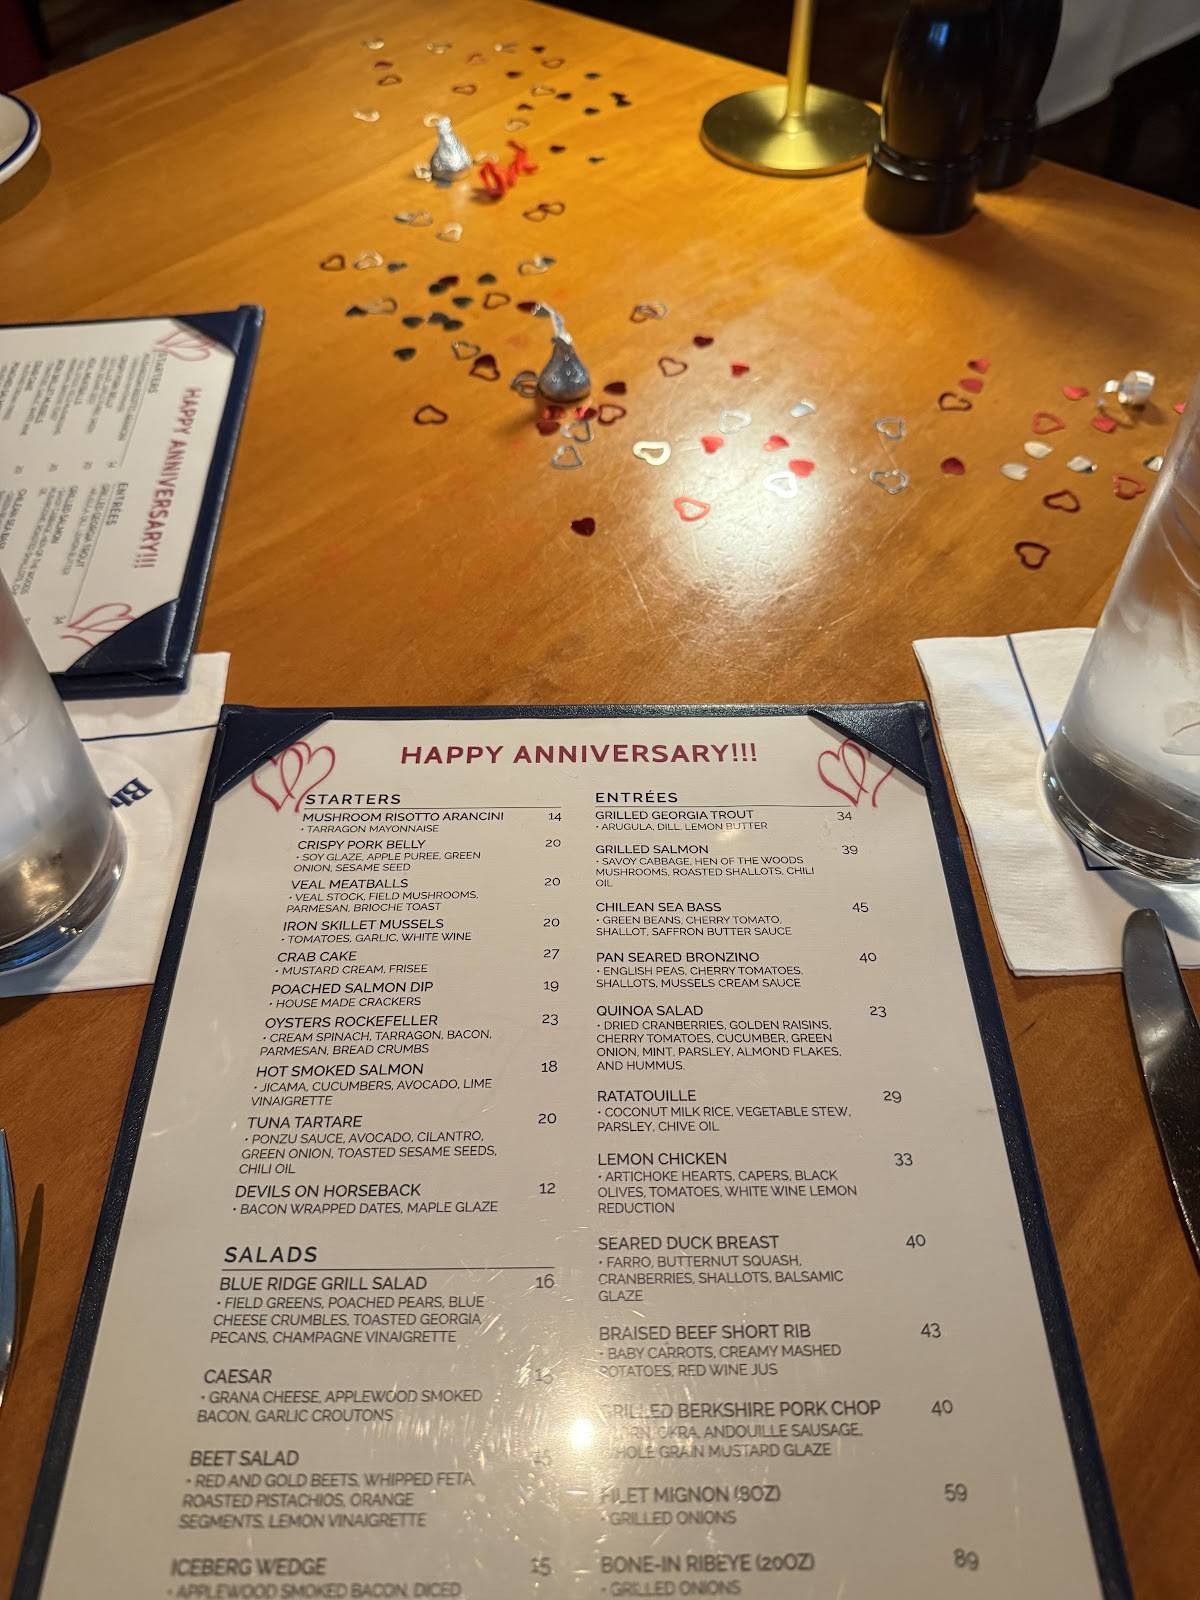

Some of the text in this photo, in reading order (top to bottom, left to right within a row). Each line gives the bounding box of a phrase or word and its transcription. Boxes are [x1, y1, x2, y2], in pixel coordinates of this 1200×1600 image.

[134, 387, 201, 569] HAPPY ANNIVERSARY!!!
[401, 742, 758, 765] HAPPY ANNIVERSARY!!!
[304, 793, 402, 805] STARTERS
[595, 789, 678, 803] ENTRÉES
[302, 811, 504, 822] MUSHROOM RISOTTO ARANCINI
[547, 812, 562, 822] 14
[594, 809, 754, 820] GRILLED GEORGIA TROUT
[836, 810, 853, 821] 34
[307, 824, 439, 833] TARRAGON MAYONNAISE
[297, 839, 426, 850] CRISPY PORK BELLY
[544, 838, 562, 848] 20
[595, 844, 709, 854] GRILLED SALMON
[841, 844, 858, 855] 39
[334, 862, 380, 872] SESAME
[382, 862, 411, 872] SEED
[290, 877, 409, 890] VEAL MEATBALLS
[544, 876, 561, 886] 20
[352, 902, 403, 912] BRIOCHE
[405, 901, 441, 911] TOAST
[595, 901, 722, 912] CHILEAN SEA BASS
[851, 901, 869, 913] 45
[282, 917, 444, 931] IRON SKILLET MUSSELS
[543, 917, 560, 927] 20
[401, 931, 439, 942] WHITE
[440, 931, 472, 941] WINE
[651, 926, 704, 936] SAFFRON
[706, 926, 752, 936] BUTTER
[753, 926, 792, 936] SAUCE
[276, 950, 357, 963] CRAB CAKE
[542, 948, 560, 960] 27
[596, 951, 760, 963] PAN SEARED BRONZINO
[858, 952, 877, 964] 40
[270, 981, 434, 995] POACHED SALMON DIP
[543, 980, 560, 992] 19
[660, 977, 716, 988] MUSSELS
[717, 977, 759, 988] CREAM
[761, 977, 801, 988] SAUCE
[275, 996, 422, 1008] HOUSE MADE CRACKERS
[596, 1004, 704, 1016] QUINOA SALAD
[869, 1005, 887, 1018] 23
[264, 1013, 438, 1028] OYSTERS ROCKEFELLER
[541, 1013, 559, 1026] 23
[332, 1044, 374, 1055] BREAD
[376, 1043, 429, 1054] CRUMBS
[255, 1062, 424, 1078] HOT SMOKED SALMON
[540, 1059, 558, 1073] 18
[250, 1094, 333, 1107] VINAIGRETTE
[597, 1089, 697, 1102] RATATOUILLE
[882, 1090, 902, 1104] 29
[537, 1112, 557, 1124] 20
[604, 1106, 668, 1118] COCONUT
[670, 1106, 701, 1117] MILK
[735, 1105, 809, 1117] VEGETABLE
[247, 1114, 363, 1129] TUNA TARTARE
[597, 1151, 727, 1166] LEMON CHICKEN
[893, 1152, 913, 1167] 33
[234, 1183, 421, 1198] DEVILS ON HORSEBACK
[538, 1182, 556, 1195] 12
[239, 1202, 288, 1215] BACON
[290, 1202, 356, 1214] WRAPPED
[406, 1201, 453, 1213] MAPLE
[454, 1200, 498, 1213] GLAZE
[597, 1201, 675, 1214] REDUCTION
[597, 1234, 780, 1251] SEARED DUCK BREAST
[905, 1233, 926, 1249] 40
[223, 1245, 317, 1263] SALADS
[219, 1275, 428, 1291] BLUE RIDGE GRILL SALAD
[535, 1272, 555, 1289] 16
[272, 1330, 363, 1344] CHAMPAGNE
[365, 1329, 457, 1343] VINAIGRETTE
[599, 1323, 811, 1341] BRAISED BEEF SHORT RIB
[920, 1322, 942, 1339] 43
[203, 1368, 273, 1384] CAESAR
[678, 1401, 776, 1418] BERKSHIRE
[779, 1399, 829, 1417] PORK
[830, 1399, 882, 1416] CHOP
[930, 1398, 954, 1416] 40
[189, 1449, 300, 1467] BEET SALAD
[653, 1485, 730, 1504] MIGNON
[944, 1482, 968, 1502] 59
[600, 1554, 681, 1574] BONE-IN
[685, 1553, 752, 1572] RIBEYE
[953, 1547, 980, 1571] 89
[169, 1556, 327, 1577] ICEBERG WEDGE
